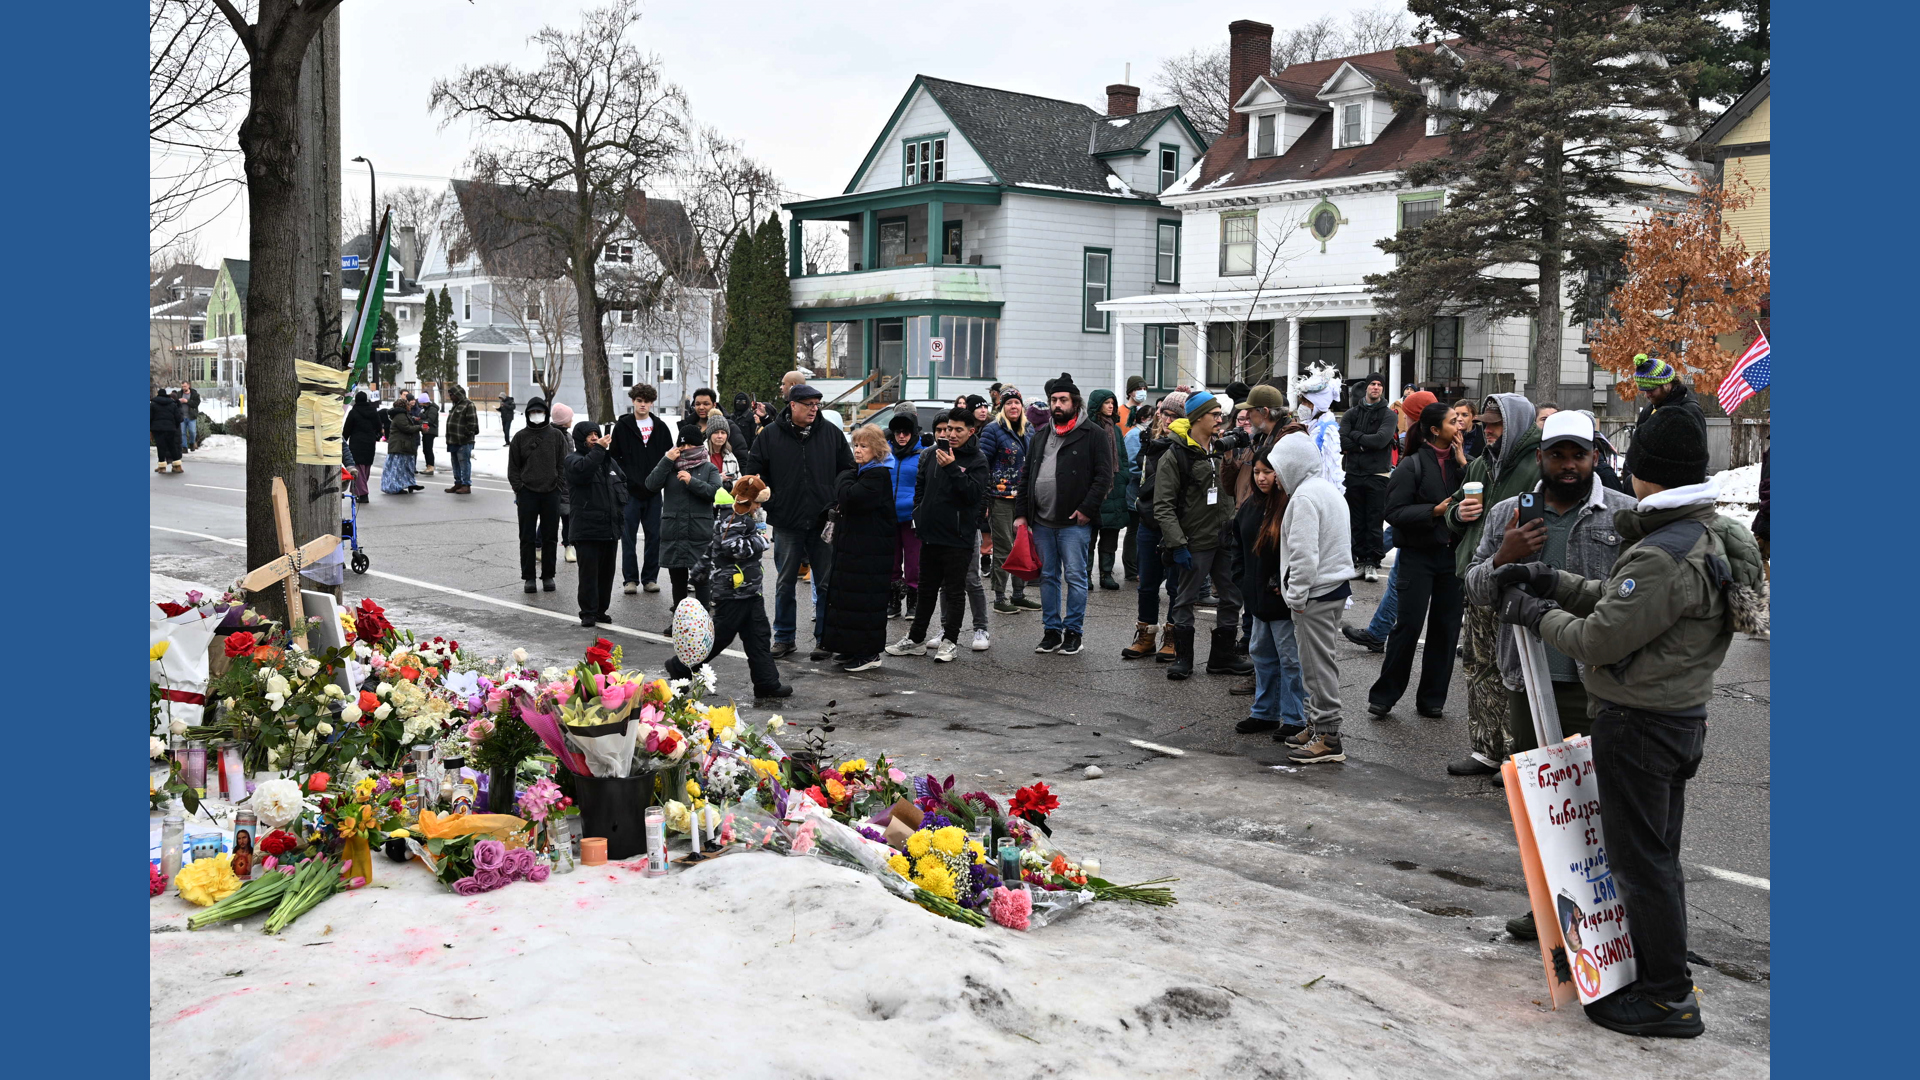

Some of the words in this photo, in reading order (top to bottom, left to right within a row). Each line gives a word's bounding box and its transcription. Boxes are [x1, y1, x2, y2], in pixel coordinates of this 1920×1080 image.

[341, 258, 350, 267] land
[1538, 763, 1582, 793] Country
[1549, 799, 1600, 830] estroying
[1570, 847, 1609, 879] igration
[1593, 876, 1617, 905] NOT
[1583, 904, 1626, 932] atorship
[1594, 932, 1635, 971] RUMP'S
